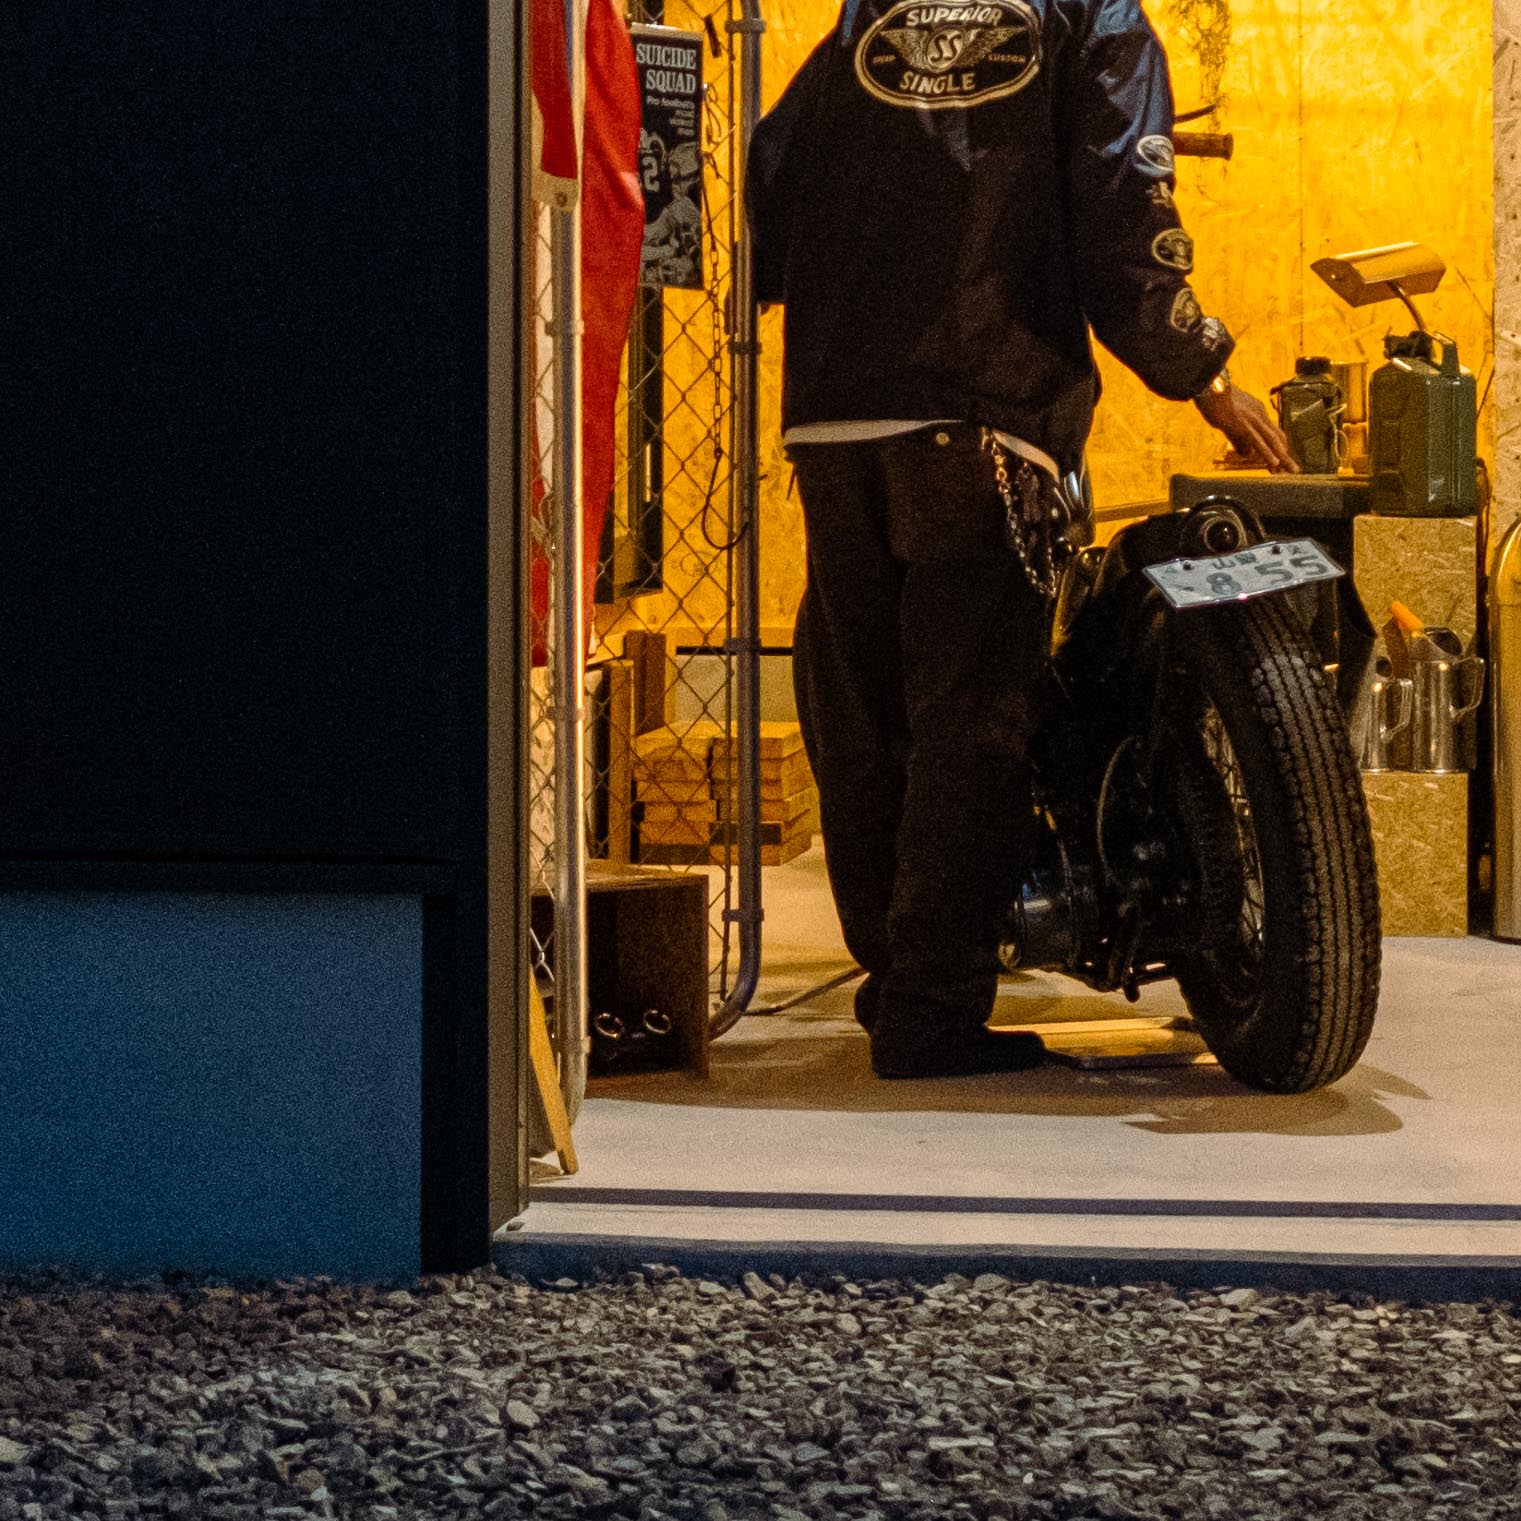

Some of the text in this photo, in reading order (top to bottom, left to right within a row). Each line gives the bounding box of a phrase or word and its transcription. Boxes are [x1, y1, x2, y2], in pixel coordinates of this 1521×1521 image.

[907, 7, 1003, 27] SUPERIOR
[636, 43, 696, 70] SUICIDE
[646, 69, 696, 94] SQUAD
[899, 71, 977, 94] SINGLE
